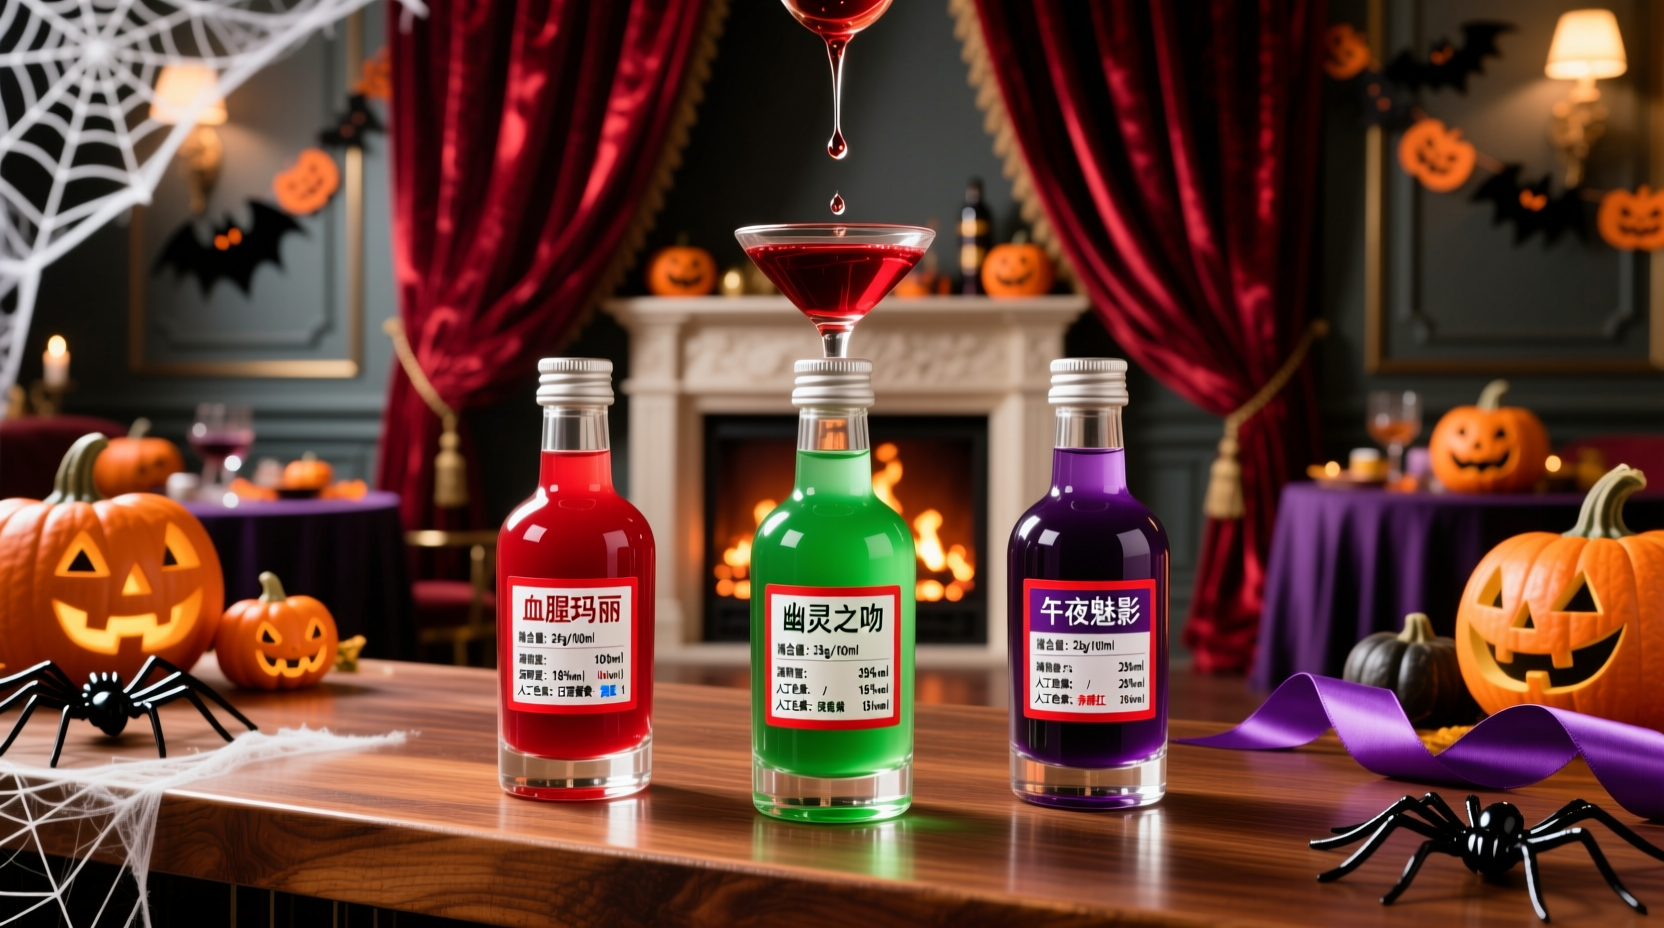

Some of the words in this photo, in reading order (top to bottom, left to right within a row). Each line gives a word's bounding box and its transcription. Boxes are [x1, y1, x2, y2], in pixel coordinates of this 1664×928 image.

[522, 594, 622, 624] 血腥玛丽
[783, 602, 884, 634] 幽灵之吻
[1041, 596, 1140, 626] 午夜魅影
